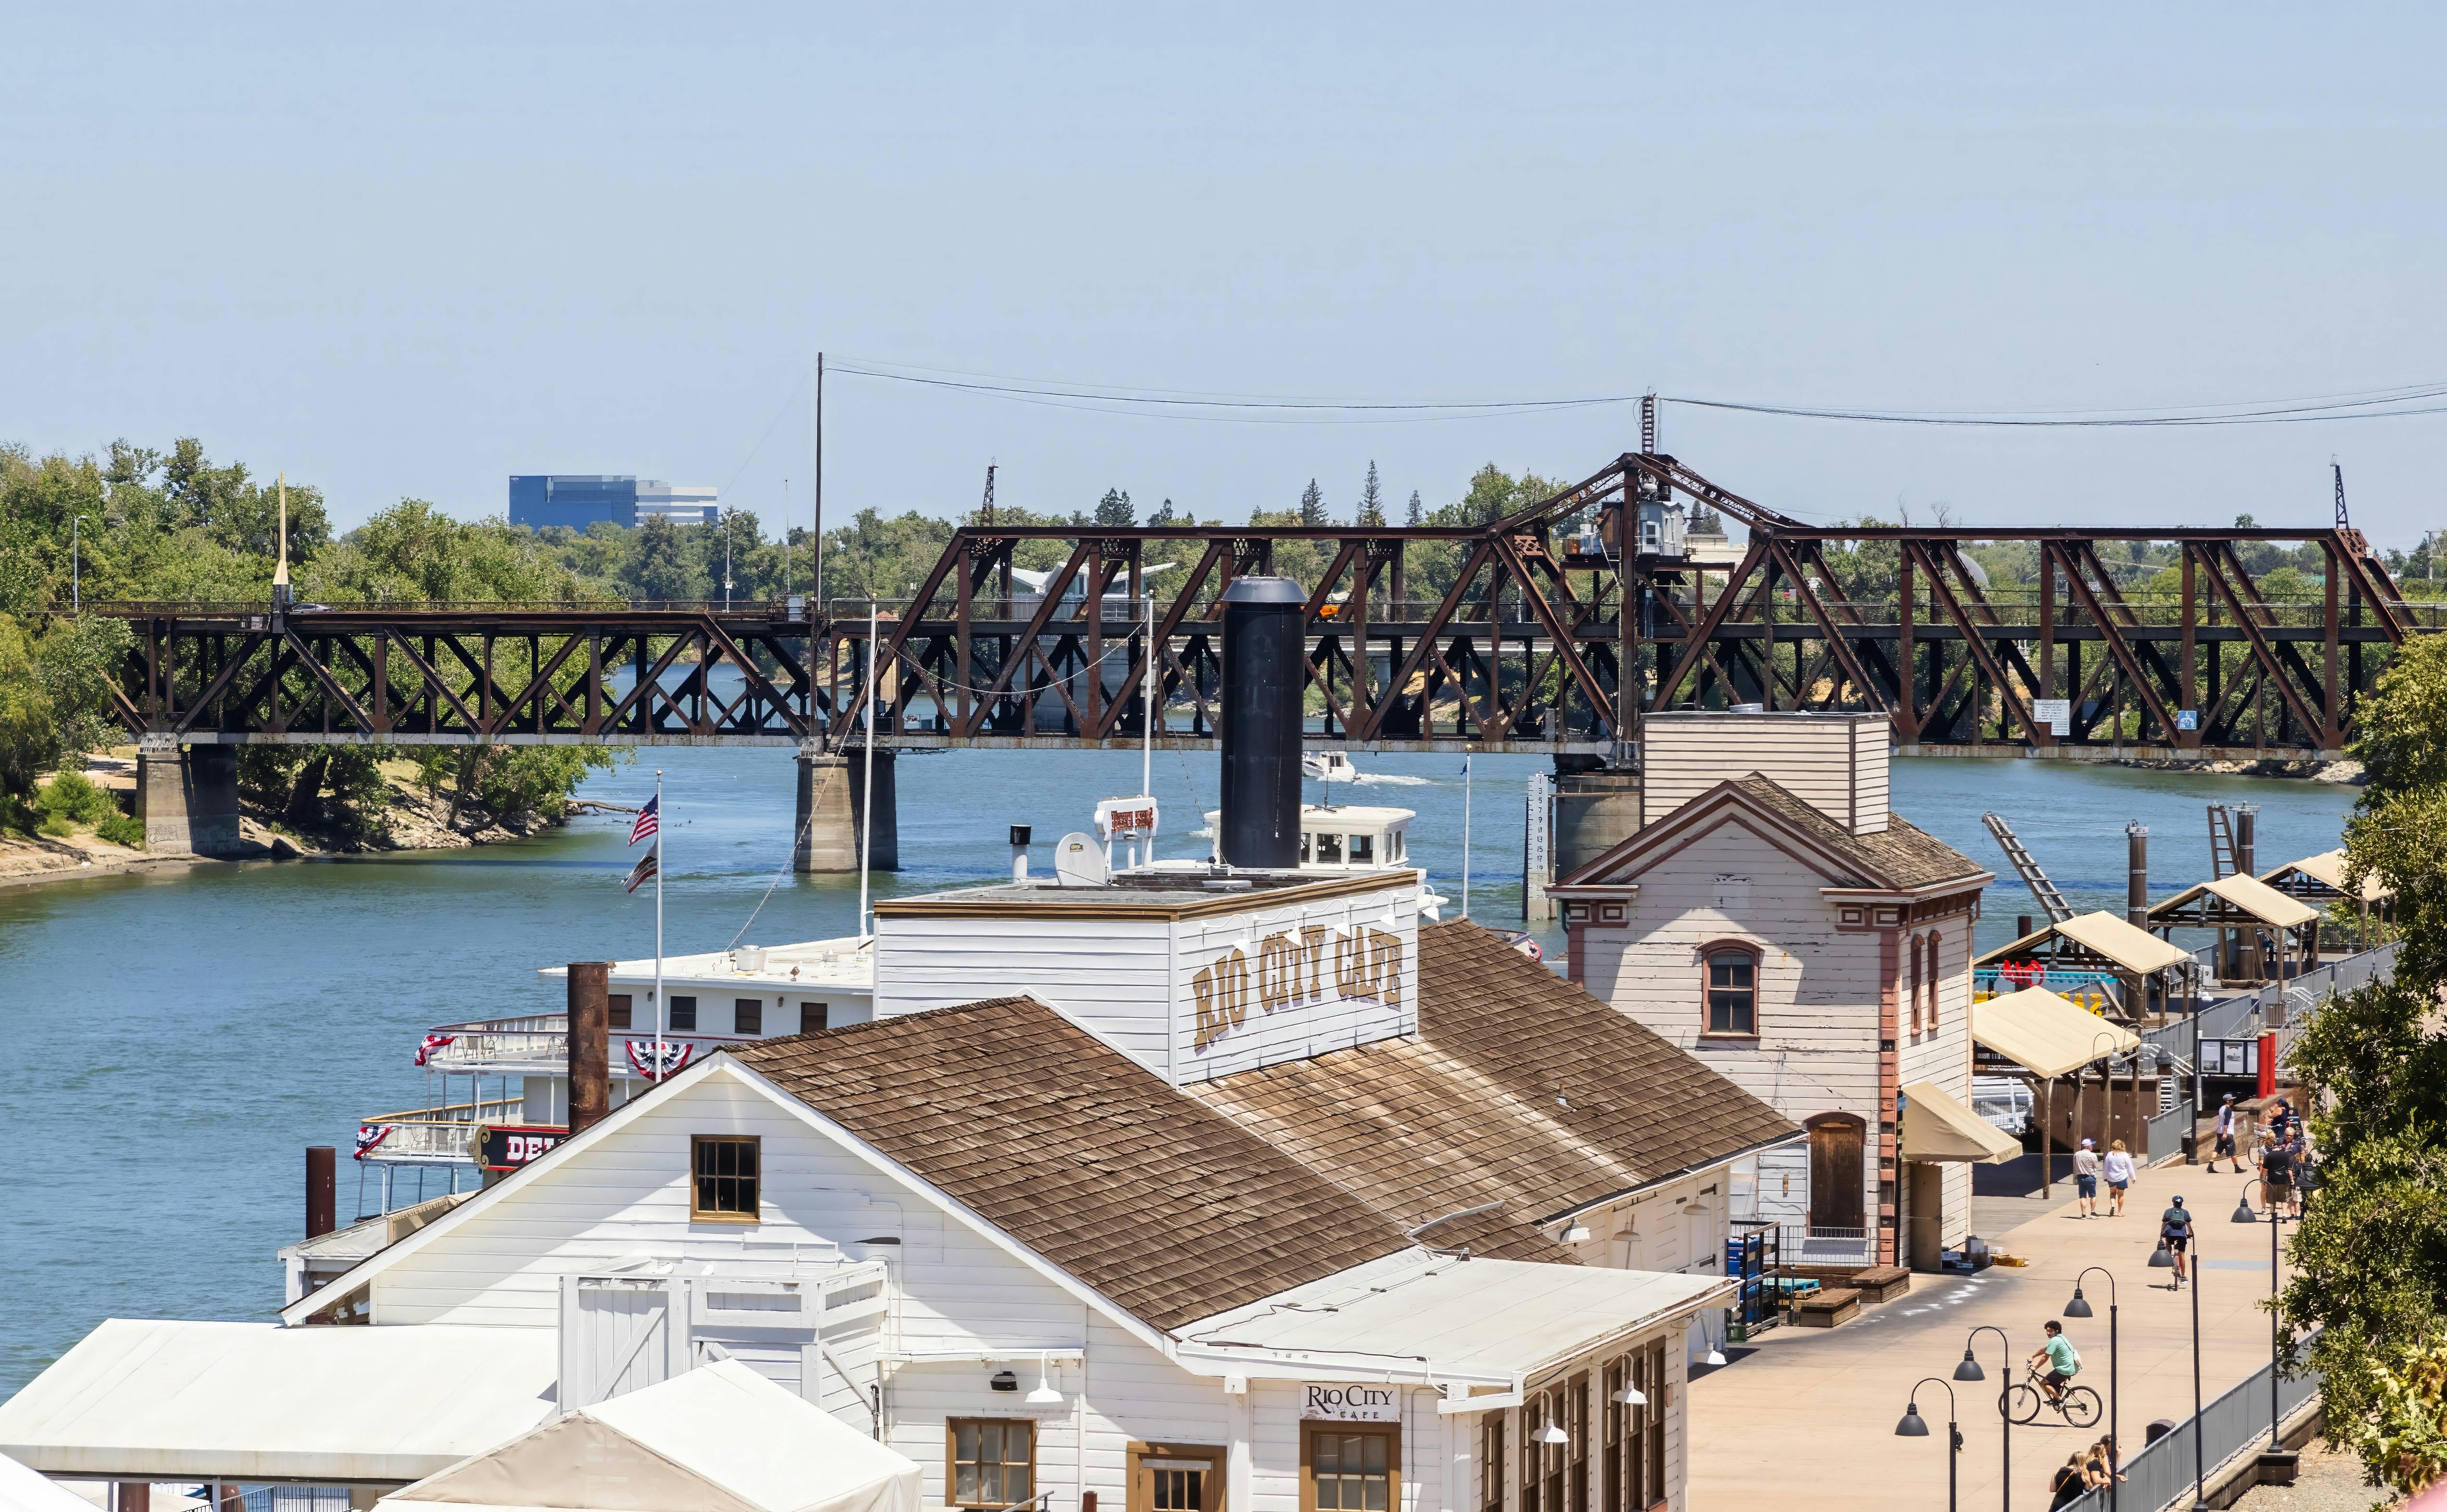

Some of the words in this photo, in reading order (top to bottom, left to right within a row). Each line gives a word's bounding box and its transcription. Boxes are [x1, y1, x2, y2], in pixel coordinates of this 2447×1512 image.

[1193, 949, 1247, 1057] RIO
[1259, 925, 1325, 1015] CITY
[1335, 926, 1402, 1012] CAFE
